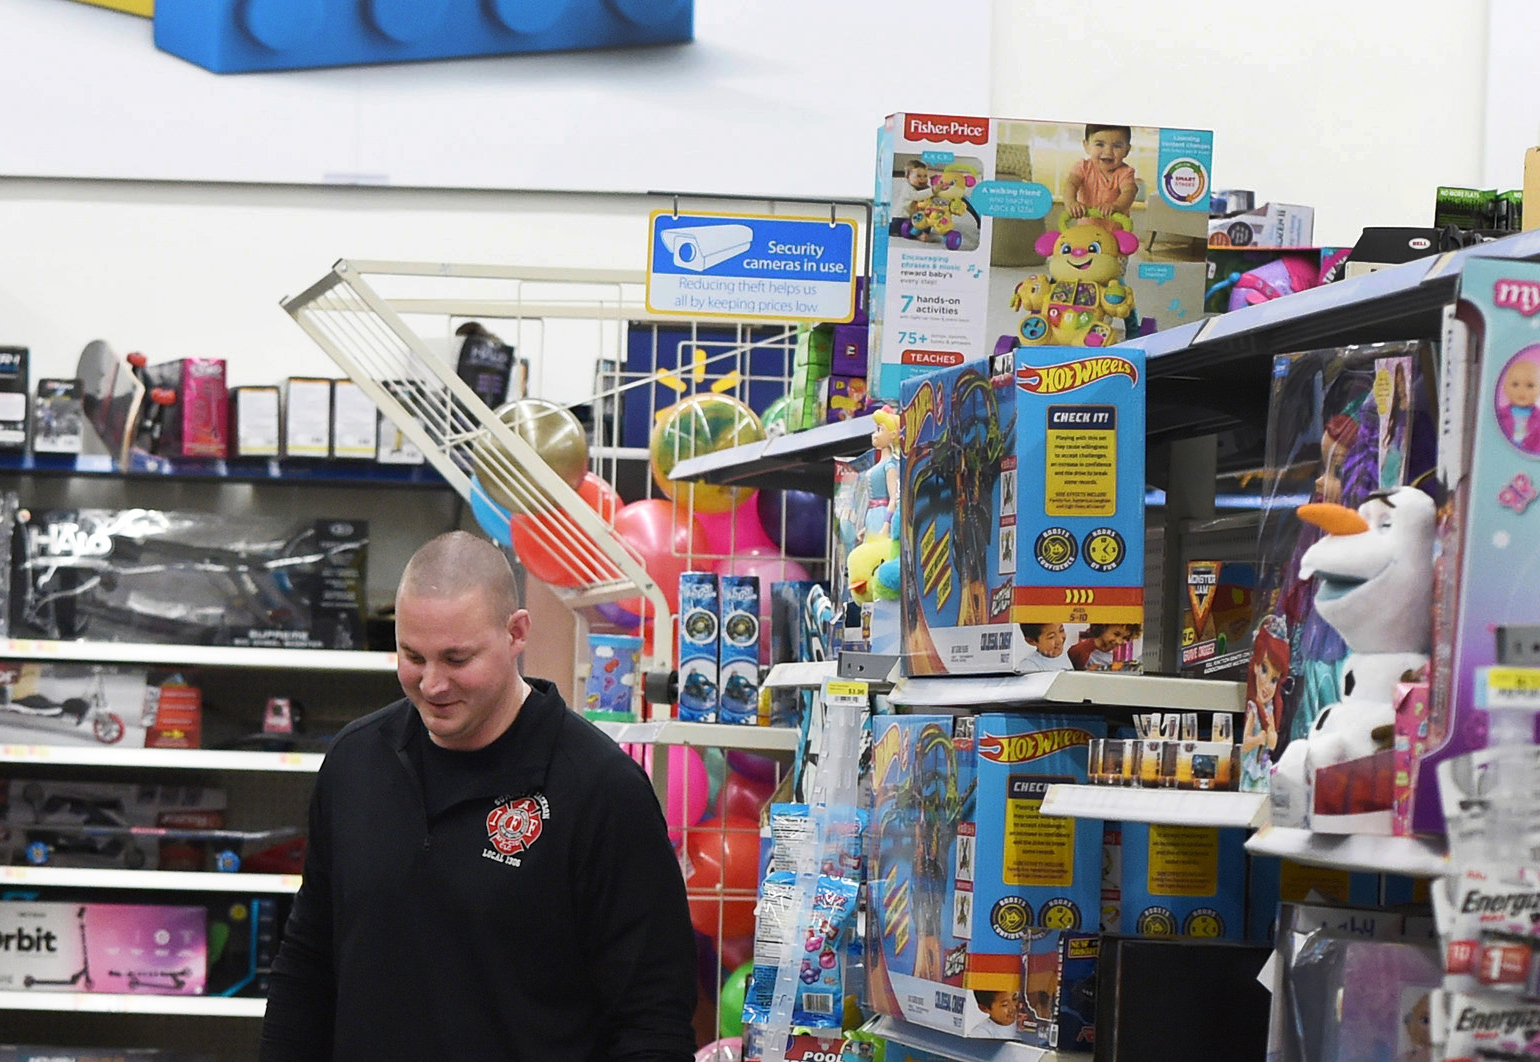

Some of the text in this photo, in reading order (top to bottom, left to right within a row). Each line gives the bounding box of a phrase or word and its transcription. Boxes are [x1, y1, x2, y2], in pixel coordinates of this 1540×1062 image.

[910, 118, 983, 138] Fisher-Price
[989, 187, 1016, 197] walking
[767, 240, 825, 260] Security
[900, 253, 949, 265] Encouraging
[743, 257, 848, 274] cameras in use.
[900, 261, 960, 272] phrases music
[900, 269, 953, 280] reward baby's
[678, 277, 818, 296] Reducing theft helps us
[674, 296, 688, 308] all
[690, 296, 705, 312] by
[707, 298, 756, 312] keeping
[758, 300, 793, 315] prices
[900, 294, 961, 314] 7 hands-on
[915, 304, 959, 316] activities
[897, 331, 928, 345] 75+
[910, 353, 956, 364] TEACHES
[1053, 412, 1109, 423] CHECK IT!
[1042, 527, 1071, 538] BOOSTS
[1092, 528, 1117, 538] HOURS
[1036, 555, 1075, 571] CONFIDENCE
[1090, 562, 1118, 571] OF FUN
[1187, 574, 1216, 584] MONSTER
[1194, 585, 1210, 595] JAM
[1069, 613, 1088, 622] 5-10
[507, 815, 521, 832] F
[524, 818, 539, 837] F
[481, 848, 505, 863] LOCAL
[1488, 948, 1503, 979] 1
